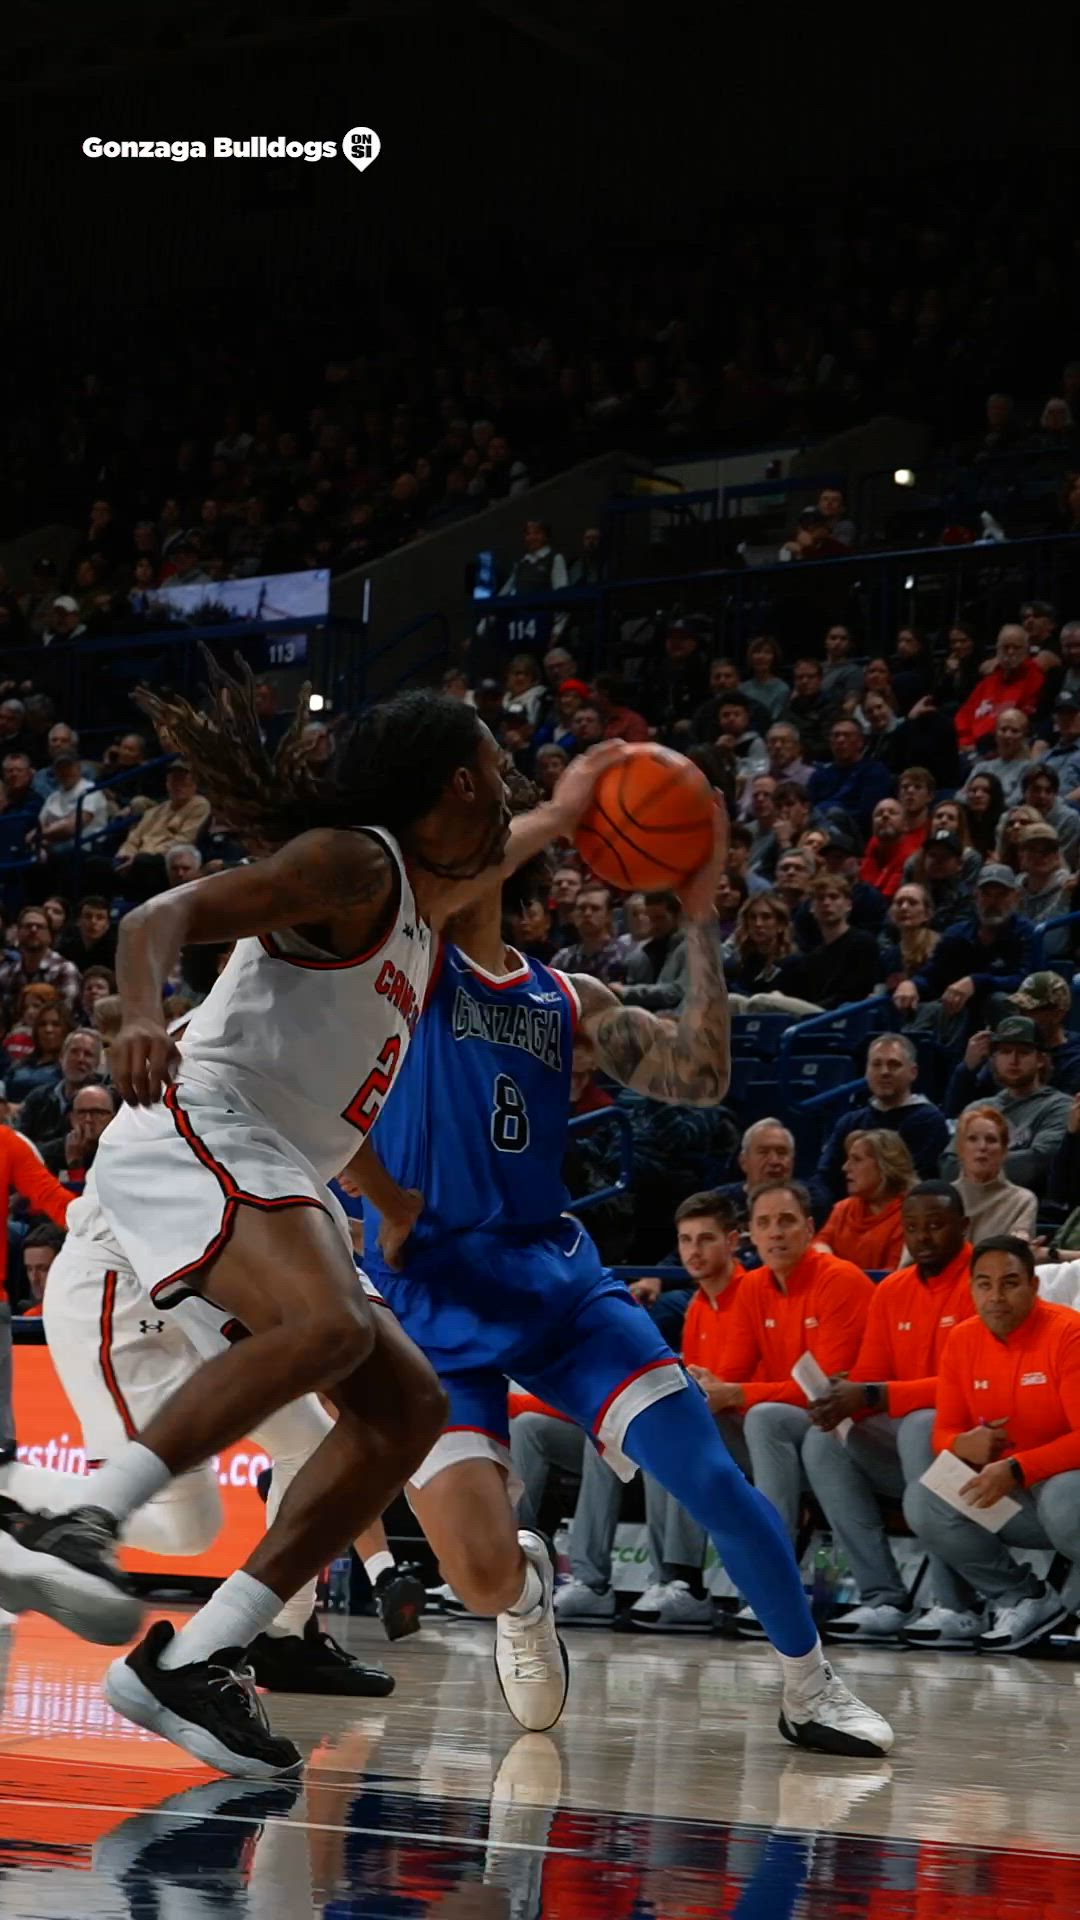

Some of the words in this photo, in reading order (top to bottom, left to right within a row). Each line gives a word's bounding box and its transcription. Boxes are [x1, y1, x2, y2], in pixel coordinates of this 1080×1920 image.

[508, 618, 536, 641] 114
[269, 643, 295, 663] 113
[491, 1072, 530, 1153] 8
